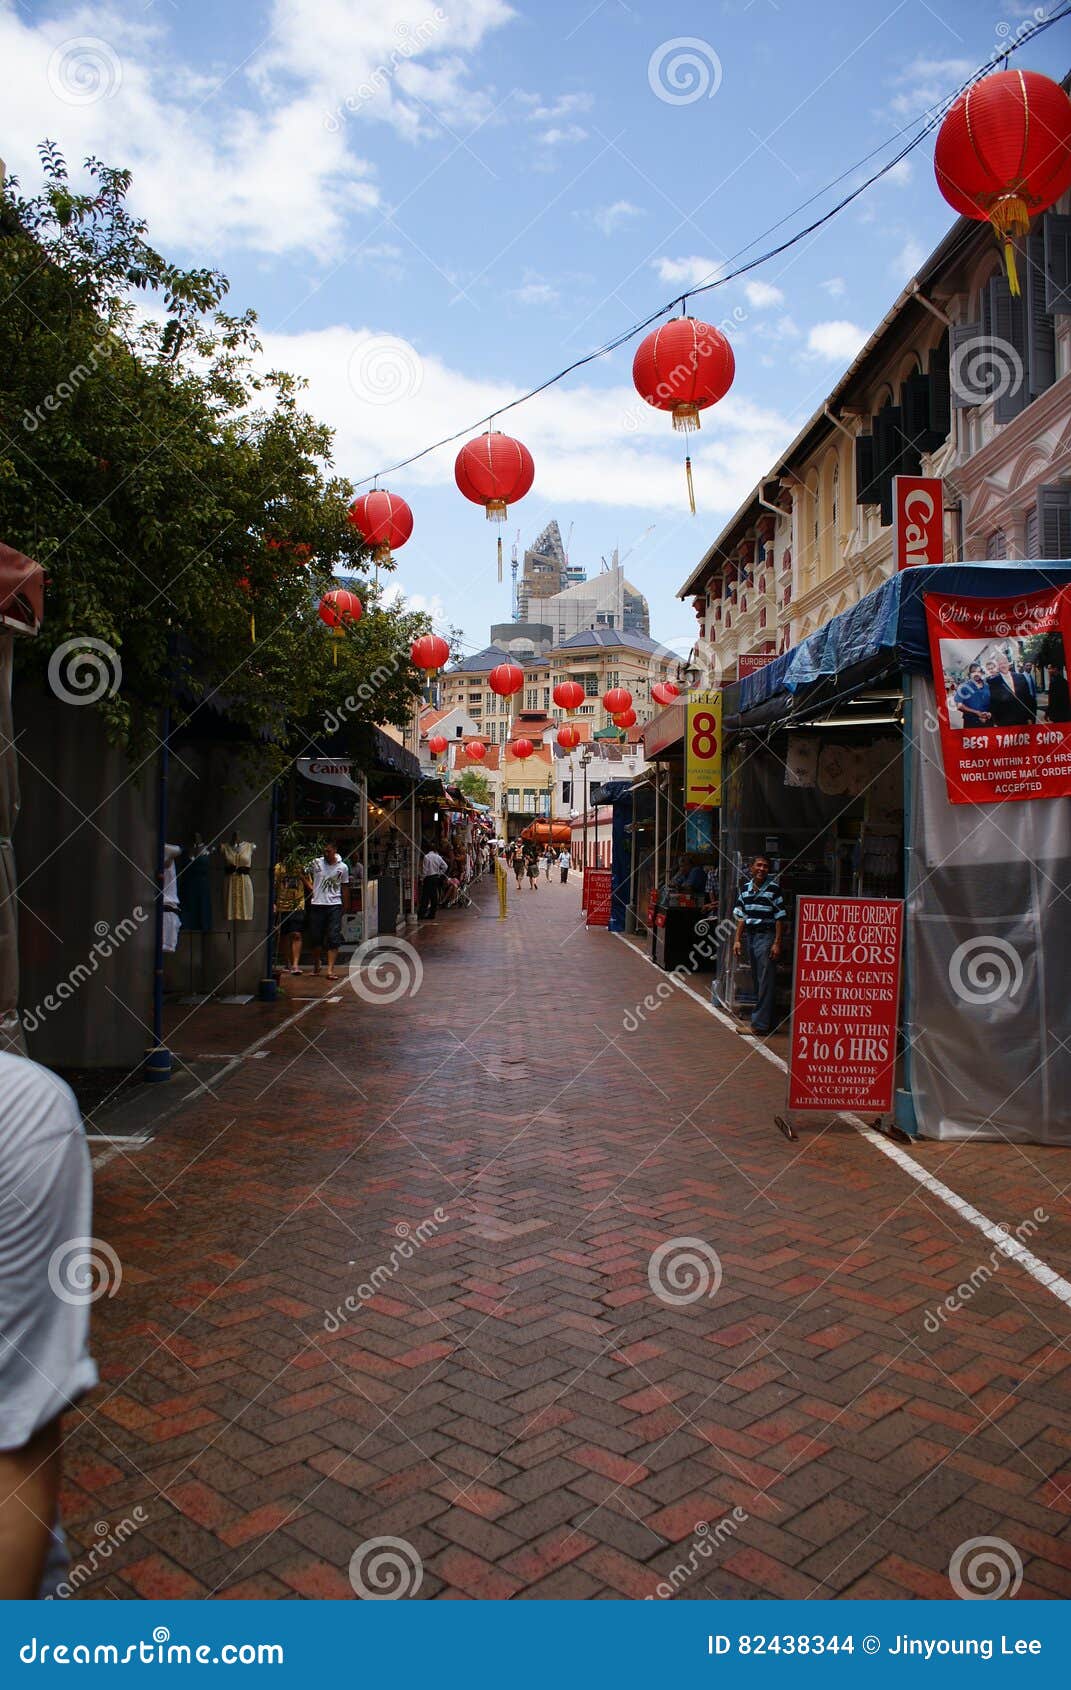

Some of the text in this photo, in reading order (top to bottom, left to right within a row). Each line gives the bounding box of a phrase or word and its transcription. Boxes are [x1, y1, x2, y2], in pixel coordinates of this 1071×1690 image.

[939, 601, 971, 626] Silk
[973, 607, 986, 629] of
[988, 607, 1007, 620] the
[740, 657, 776, 666] EUROBES
[692, 712, 717, 759] 8
[962, 731, 1064, 749] BEST TAILOR SHOP
[960, 753, 1071, 768] READY WITHIN 2 TO 6 HRS
[961, 770, 1017, 782] WORLDWIDE
[1019, 769, 1040, 778] MAIL
[995, 782, 1042, 793] ACCEPTED
[803, 904, 898, 925] SILK OF THE ORIENT
[802, 924, 897, 944] LADIES & GENTS
[801, 944, 895, 965] TAILORS
[801, 969, 893, 984] LADIES & GENTS
[800, 986, 893, 1001] SUITS TROUSERS
[819, 1004, 872, 1017] & SHIRTS
[799, 1021, 890, 1036] READY WITHIN
[797, 1036, 889, 1062] 2 to 6 HRS
[808, 1064, 878, 1074] WORLDWIDE
[806, 1075, 875, 1085] MAIL ORDER
[811, 1086, 870, 1095] ACCEPTED
[795, 1097, 885, 1106] ALTERATIONS AVAILABLE
